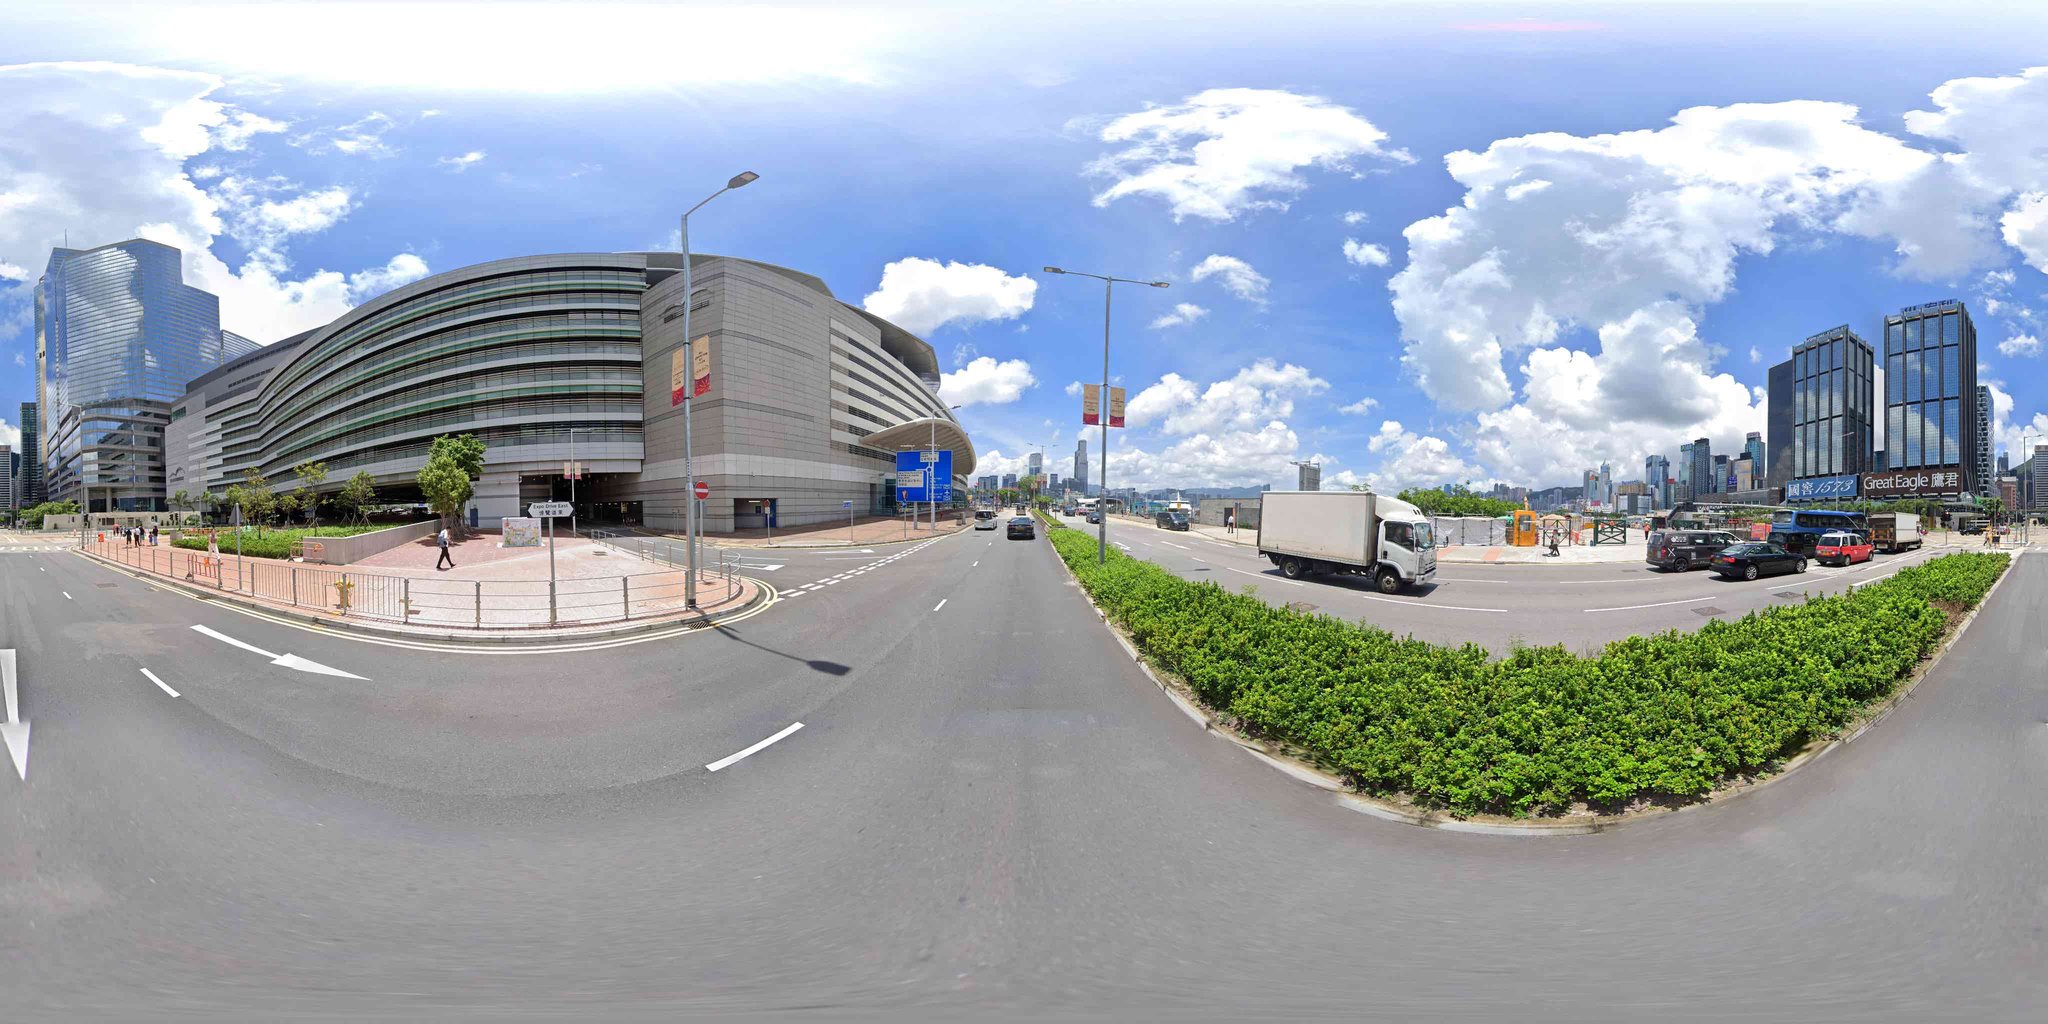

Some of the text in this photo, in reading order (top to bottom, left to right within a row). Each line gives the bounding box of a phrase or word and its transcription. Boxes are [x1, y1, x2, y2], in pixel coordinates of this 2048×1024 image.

[1815, 479, 1854, 494] 1573
[1863, 472, 1929, 491] Great Eagle
[1931, 472, 1959, 488] 鷹君
